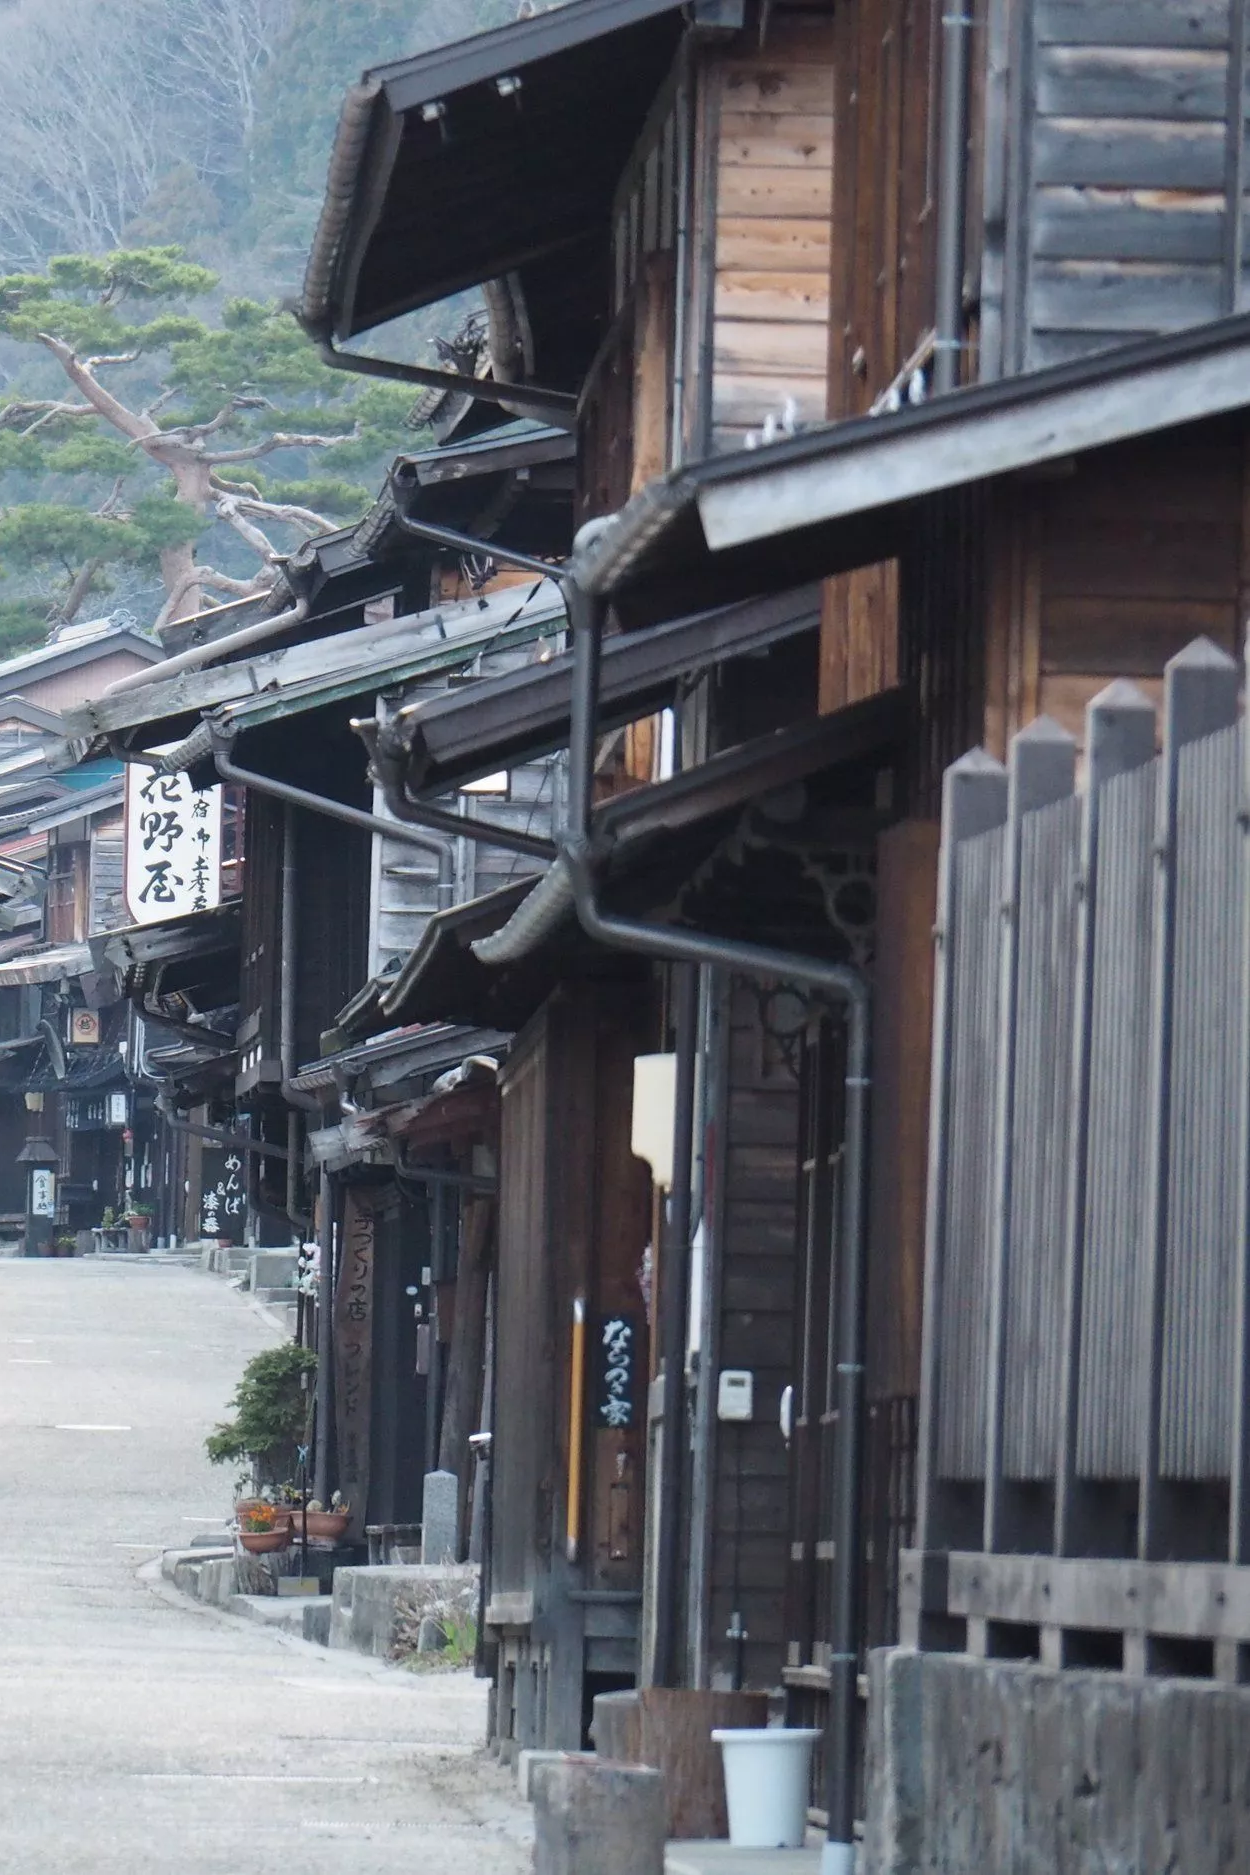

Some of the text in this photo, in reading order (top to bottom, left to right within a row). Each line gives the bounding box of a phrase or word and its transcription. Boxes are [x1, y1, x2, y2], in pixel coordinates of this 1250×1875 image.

[138, 769, 184, 904] 花野屋
[216, 1181, 226, 1196] &
